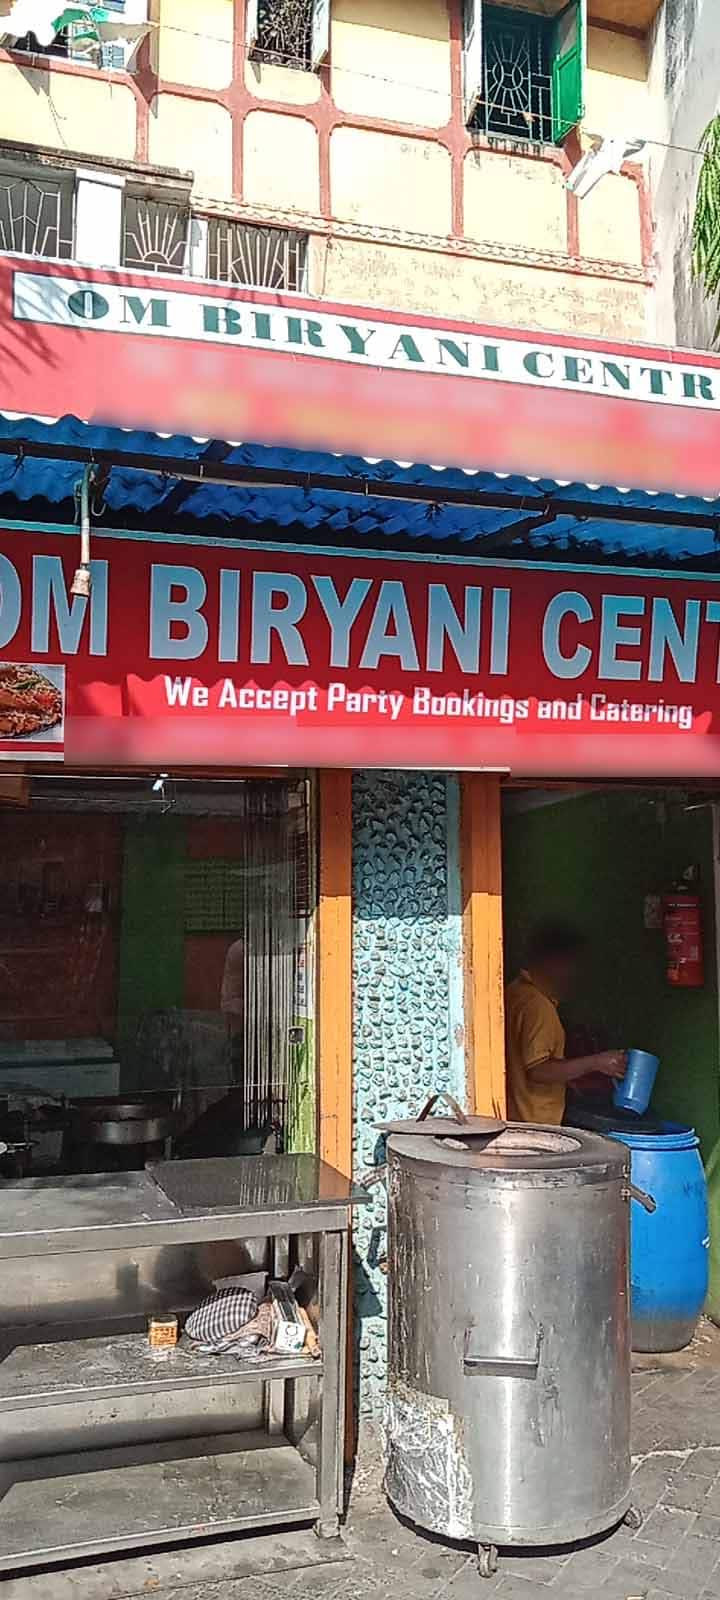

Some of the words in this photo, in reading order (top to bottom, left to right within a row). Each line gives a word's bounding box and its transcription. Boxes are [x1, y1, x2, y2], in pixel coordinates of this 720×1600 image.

[67, 289, 171, 327] OM
[199, 304, 502, 373] BIRYANI
[149, 563, 511, 675] BIRYANI
[164, 675, 209, 707] We
[218, 678, 318, 717] Accept
[327, 683, 404, 720] Party
[413, 687, 529, 724] Bookings
[537, 693, 582, 720] and
[590, 693, 692, 729] Catering
